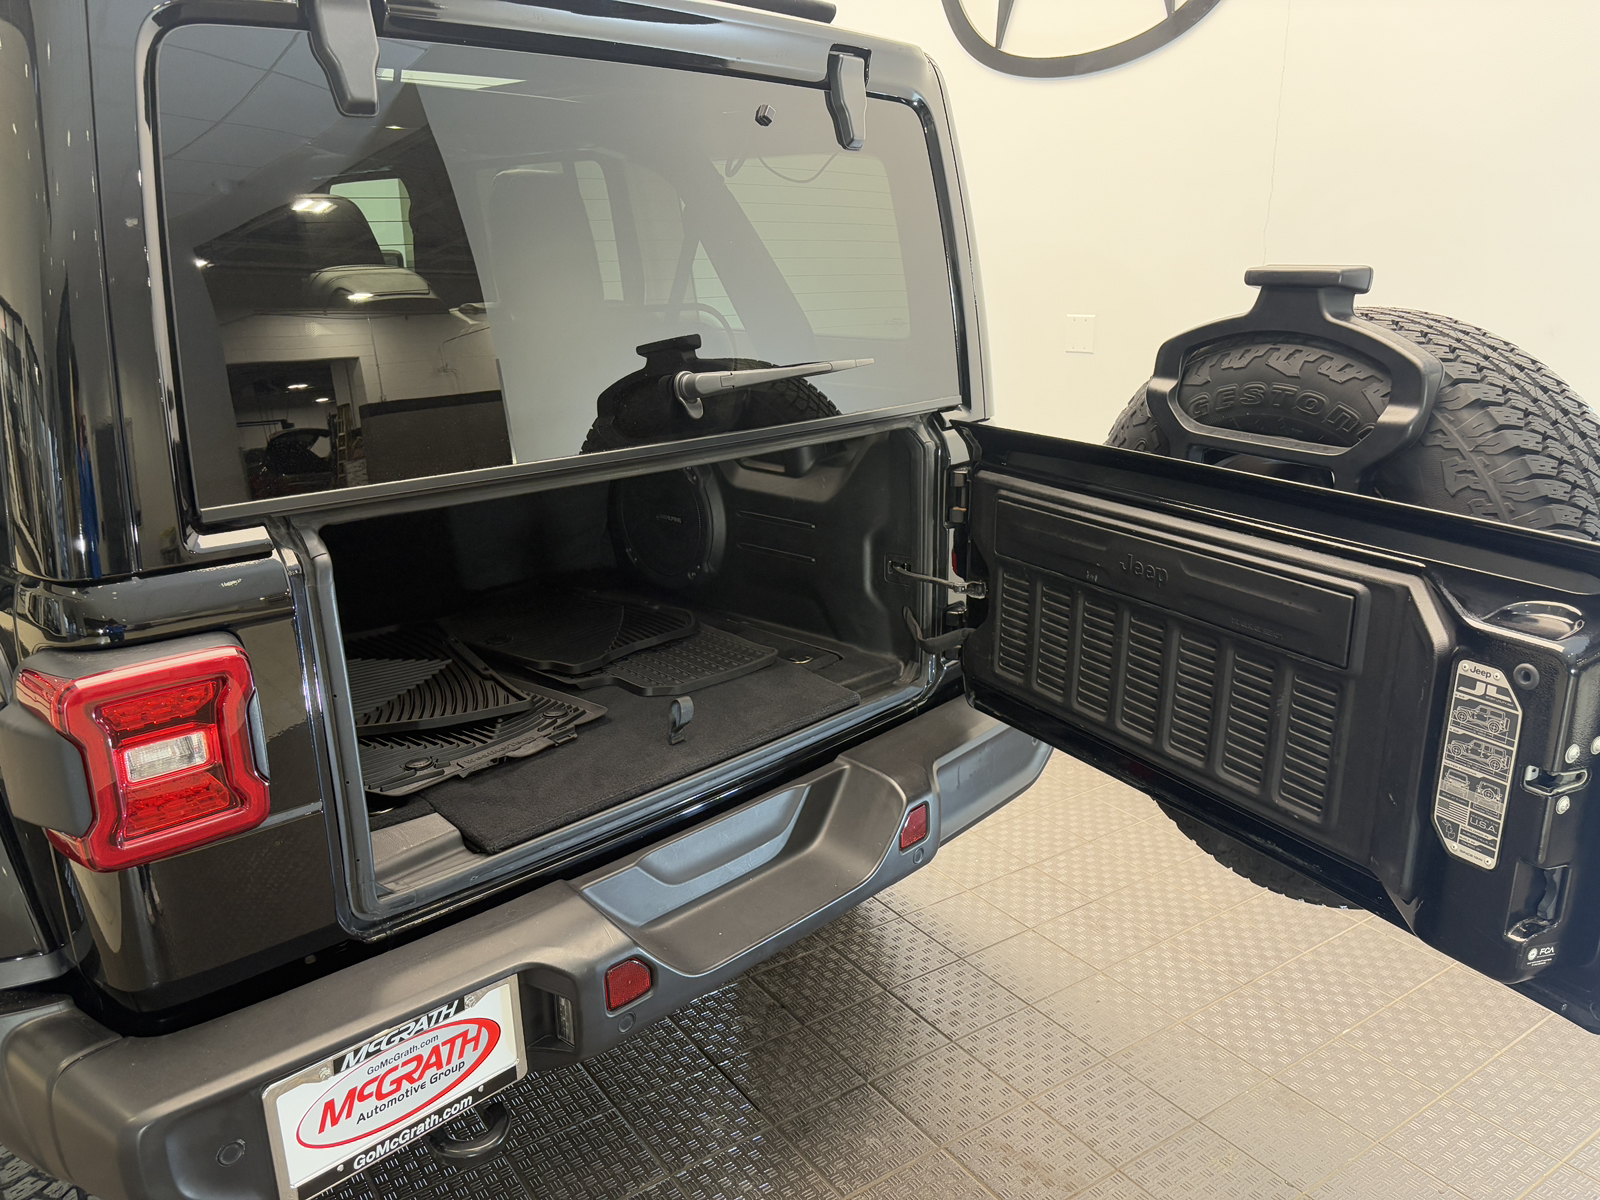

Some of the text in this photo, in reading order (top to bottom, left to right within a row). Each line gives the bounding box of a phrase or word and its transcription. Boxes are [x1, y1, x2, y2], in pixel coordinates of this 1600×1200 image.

[1119, 553, 1169, 588] Jeep
[1470, 666, 1491, 679] Jeep
[1458, 681, 1512, 703] JL
[1539, 946, 1555, 955] FCA
[366, 1033, 439, 1076] GoMcGrath.com
[356, 1061, 466, 1125] Automotive Group
[353, 1095, 473, 1170] GoMcGrath.com
